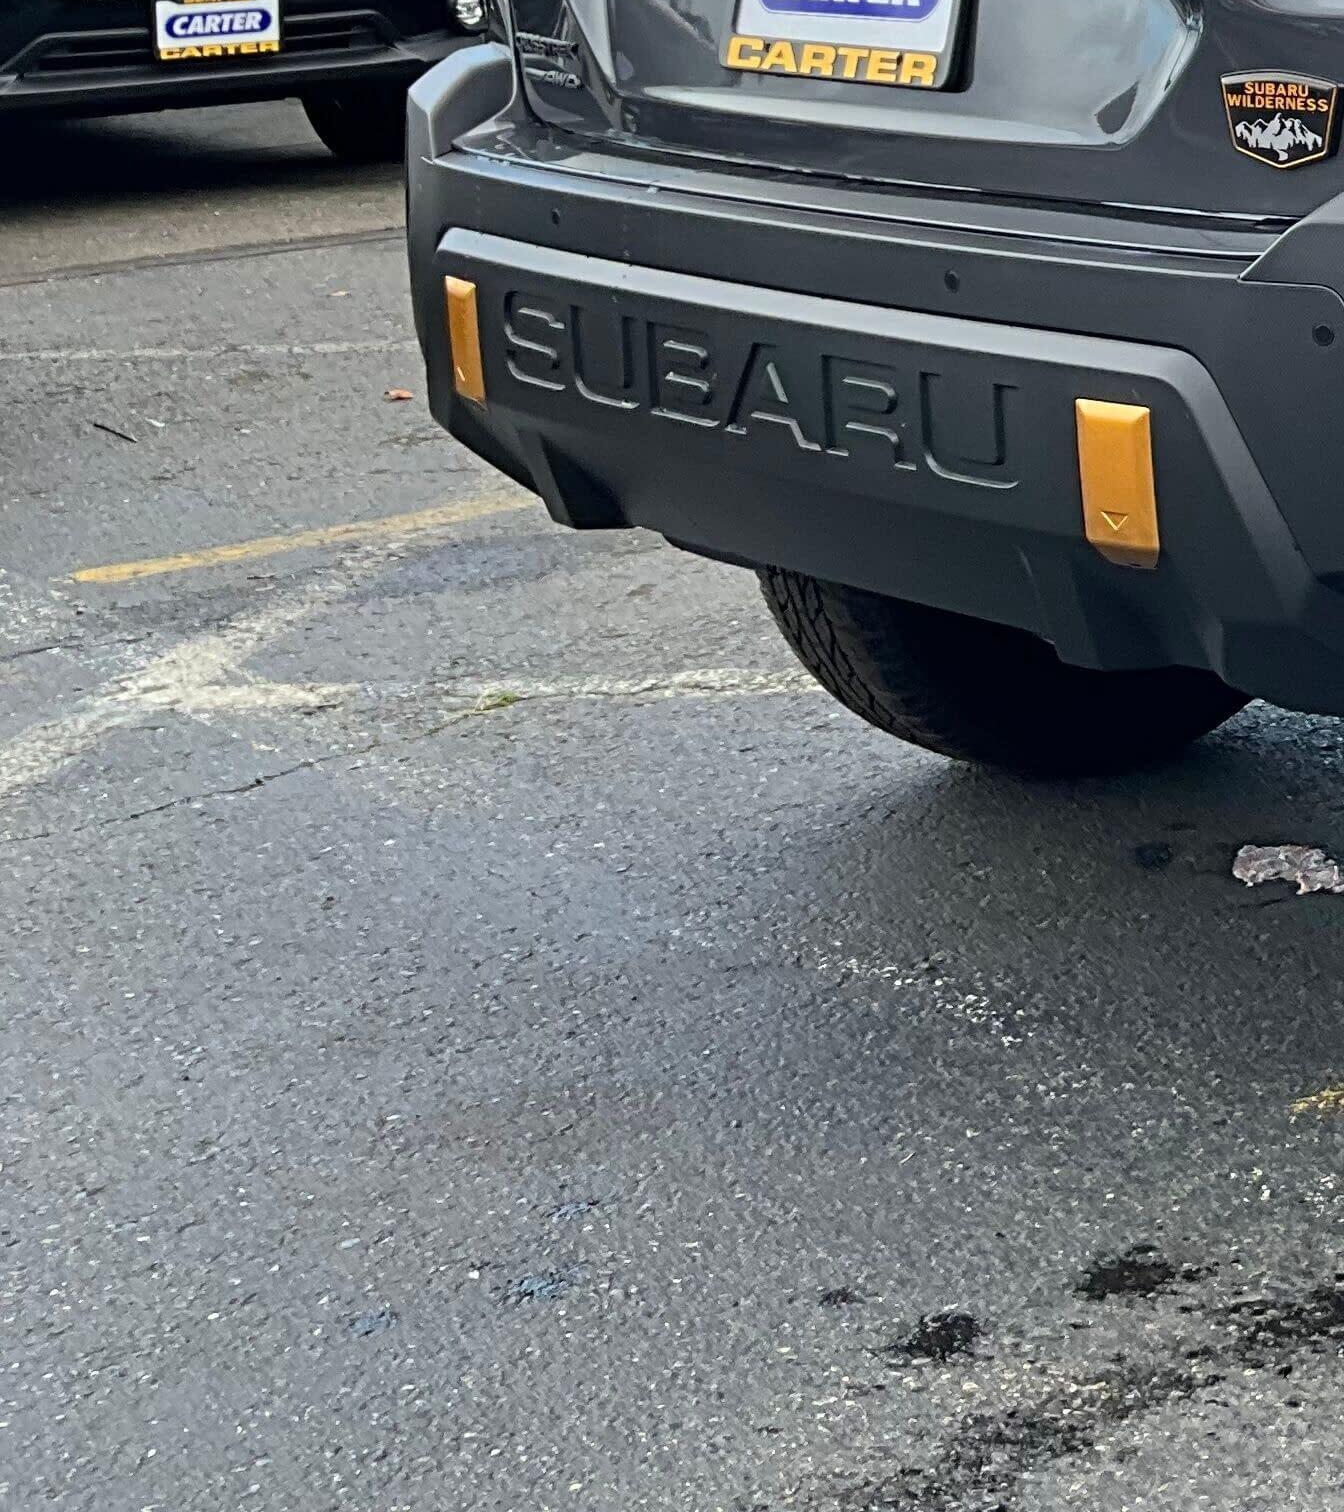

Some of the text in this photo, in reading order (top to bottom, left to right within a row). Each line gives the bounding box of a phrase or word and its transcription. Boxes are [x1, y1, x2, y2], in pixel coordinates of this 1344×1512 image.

[172, 11, 263, 36] CARTER
[160, 40, 279, 60] CARTER
[727, 37, 937, 86] CARTER
[1244, 81, 1309, 98] SUBARU
[1227, 93, 1329, 112] WILDERNESS
[504, 290, 1020, 489] SUBARU
